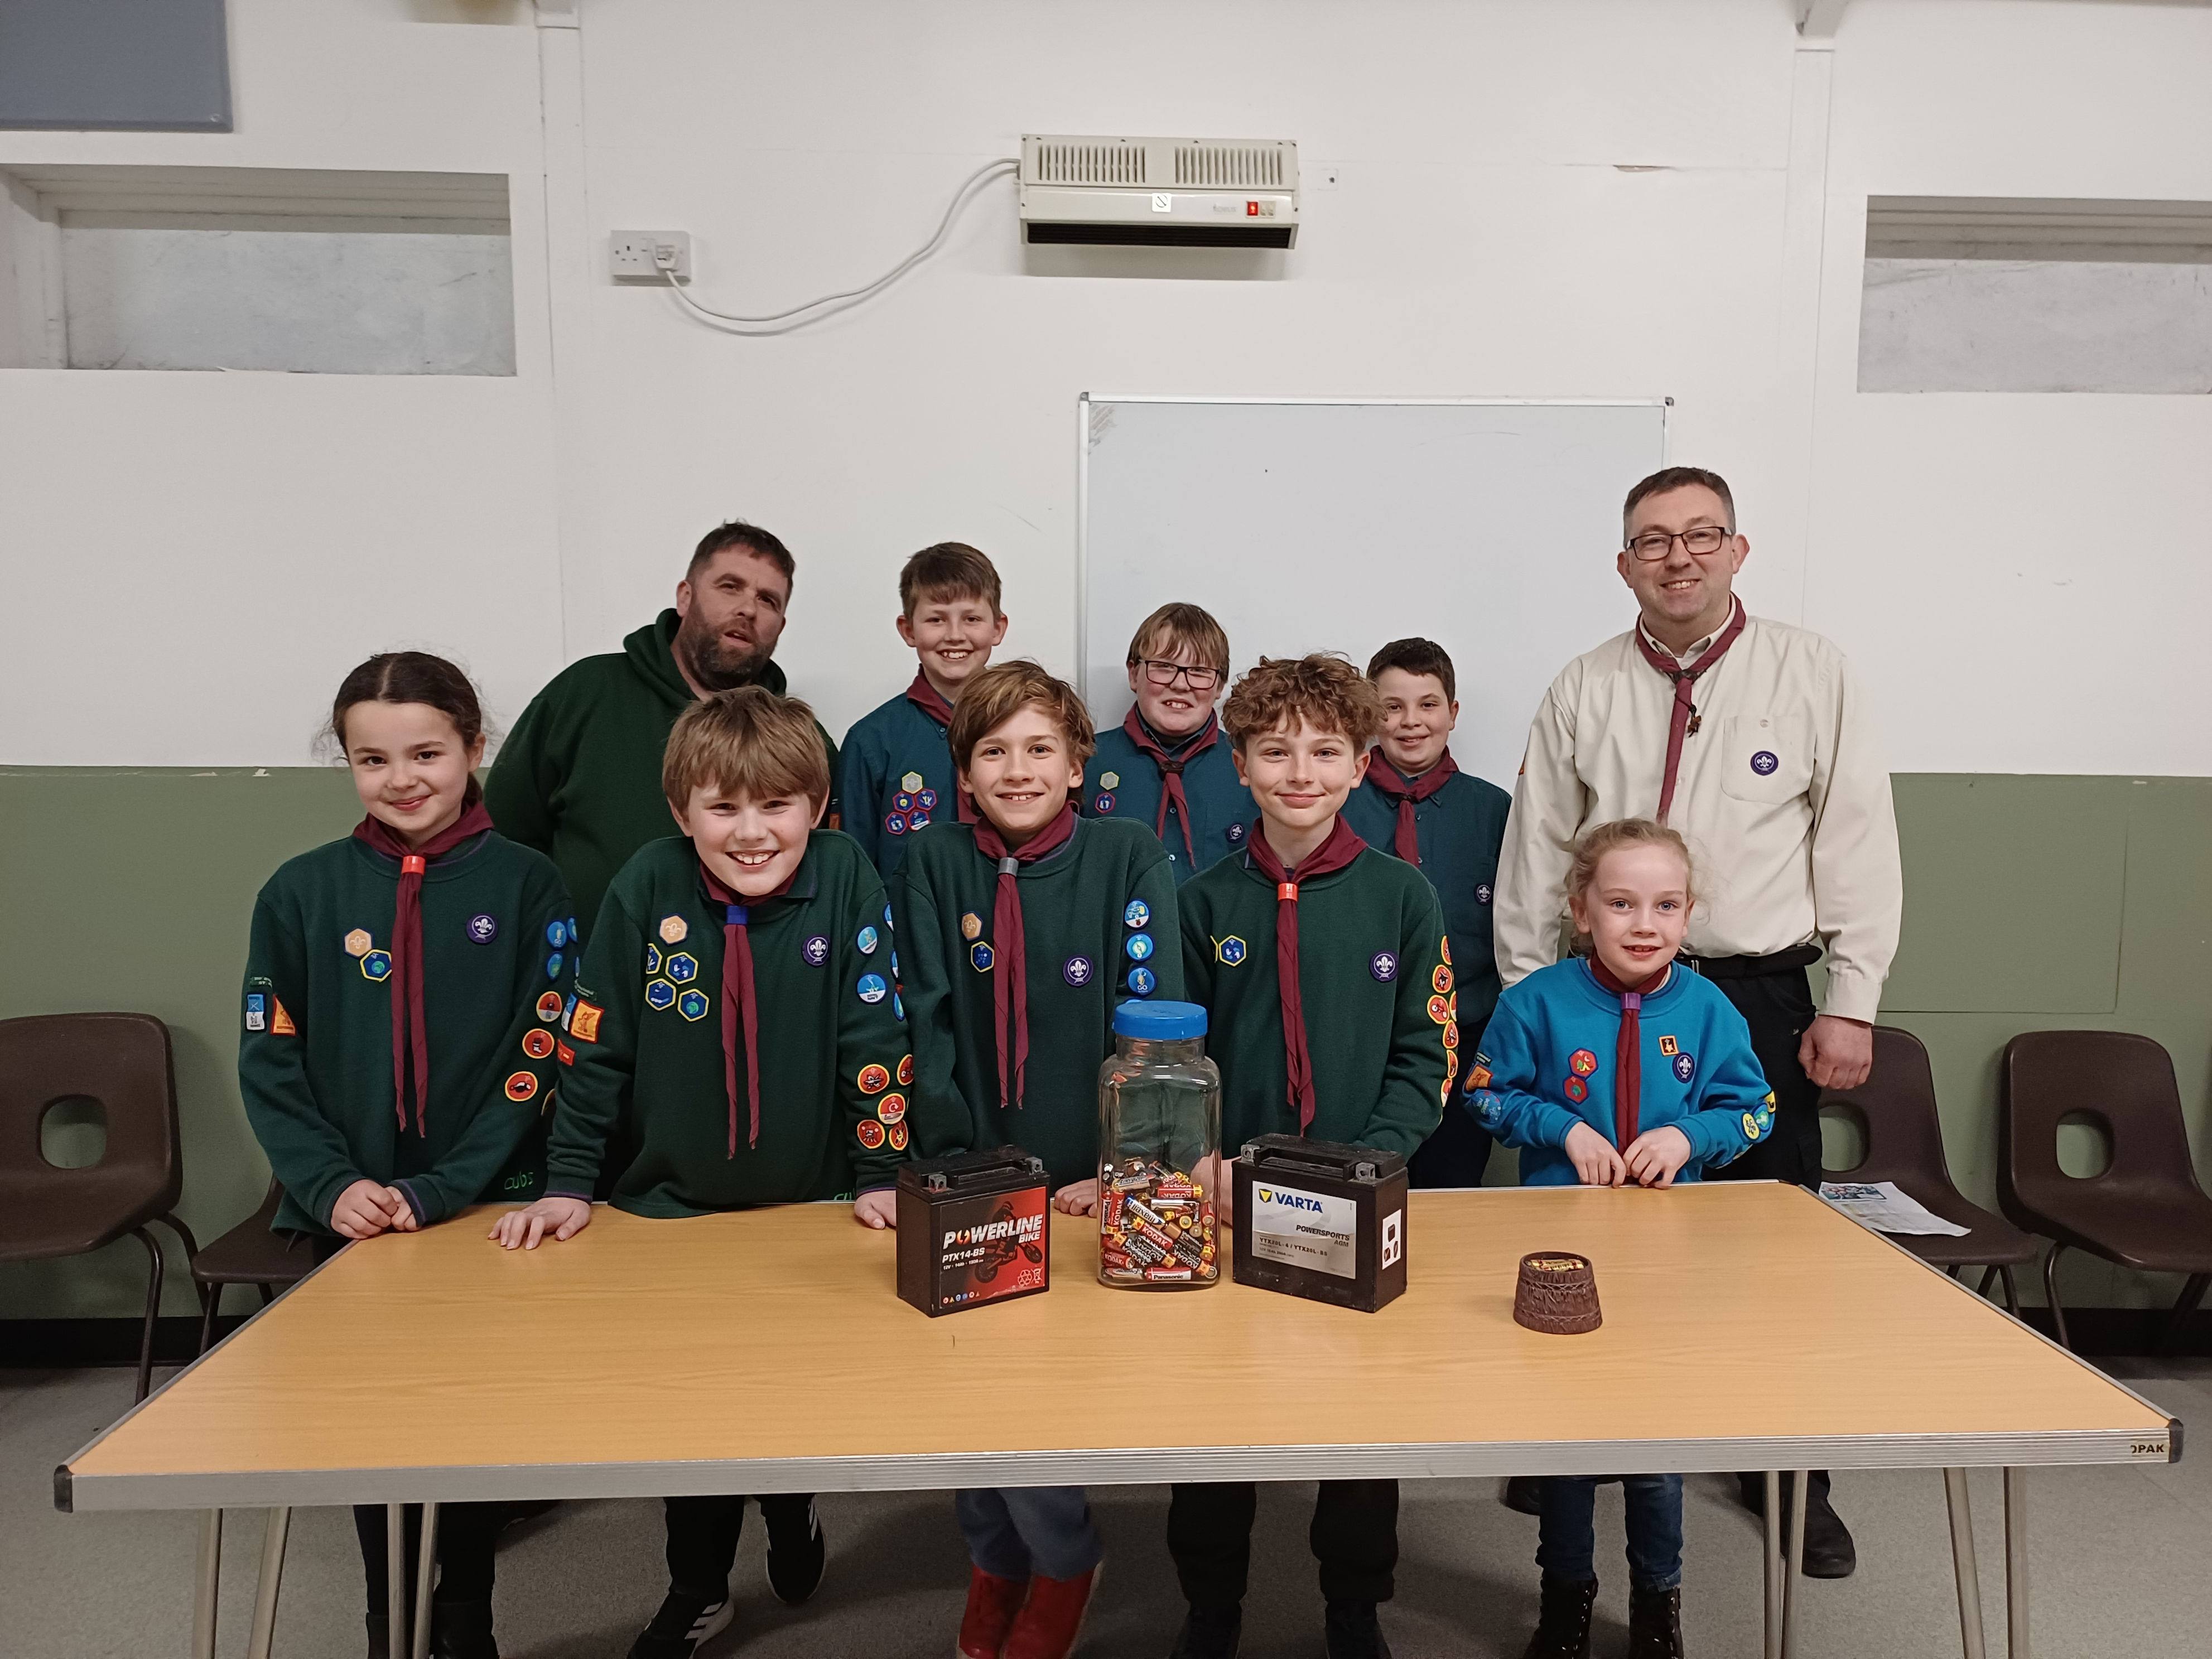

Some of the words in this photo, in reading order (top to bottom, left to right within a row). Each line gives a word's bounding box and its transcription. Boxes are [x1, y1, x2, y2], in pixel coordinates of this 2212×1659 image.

[1114, 1199, 1124, 1226] KODAK
[1275, 1192, 1323, 1213] VARTA
[1130, 1203, 1156, 1224] maxell
[943, 1214, 1043, 1250] POWERLINE
[1018, 1231, 1041, 1243] BIKE
[1142, 1226, 1168, 1247] KODAK
[1296, 1224, 1350, 1241] POWERSPORTS
[942, 1247, 985, 1263] PTX14-BS
[1105, 1253, 1124, 1265] KODAK
[1173, 1249, 1199, 1270] KODAK
